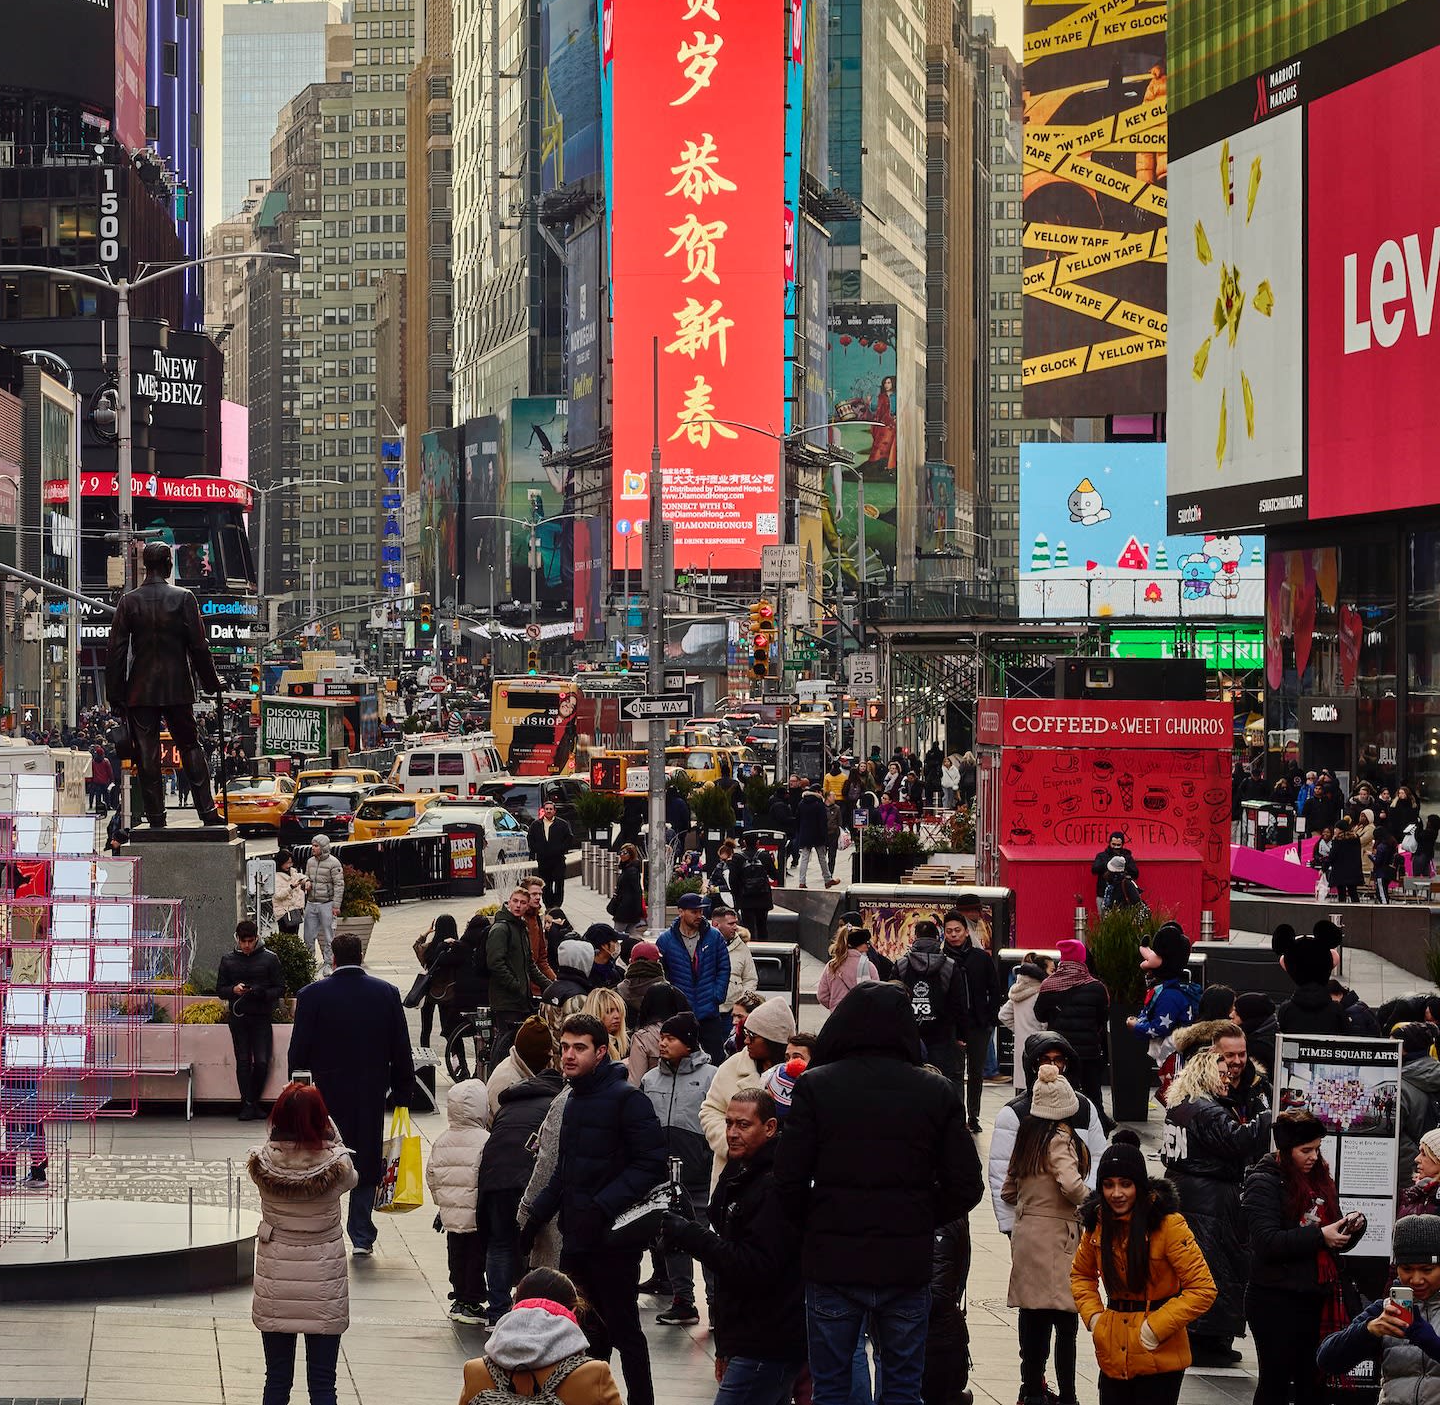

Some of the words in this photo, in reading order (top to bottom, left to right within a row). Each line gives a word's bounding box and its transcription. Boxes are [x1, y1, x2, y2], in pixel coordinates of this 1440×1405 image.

[1104, 20, 1127, 35] KEY
[1130, 12, 1167, 29] GLOCK
[1054, 31, 1083, 46] TAPE
[1269, 60, 1302, 89] MARRIOTT
[1270, 84, 1298, 110] MARQUIS
[1125, 111, 1148, 128] KEY
[1076, 128, 1105, 147] TAPE
[1129, 134, 1166, 145] GLOCK
[1025, 145, 1052, 163] TAPE
[1070, 163, 1094, 179] KEY
[1095, 173, 1131, 194] GLOCK
[100, 168, 119, 263] 1500
[1034, 231, 1079, 245] YELLOW
[1066, 252, 1111, 273] YELLOW
[1114, 243, 1143, 260] TAPE
[664, 133, 739, 449] 恭贺新春
[1075, 292, 1102, 311] TAPE
[1122, 309, 1145, 325] KEY
[1098, 342, 1144, 361] YELLOW
[162, 357, 197, 382] NEW
[1040, 357, 1077, 373] GLOCK
[162, 482, 202, 497] Watch
[206, 483, 226, 498] the
[1178, 505, 1202, 524] swatch
[771, 559, 792, 568] MUST
[210, 624, 234, 640] Dak
[853, 672, 873, 684] 25
[266, 707, 320, 719] DISCOVER
[631, 701, 652, 714] ONE
[661, 699, 684, 712] WAY
[1311, 704, 1338, 722] swatch
[503, 715, 563, 726] VERISHOP
[1012, 715, 1109, 734] COFFEED
[1120, 716, 1161, 734] SWEET
[1165, 718, 1225, 736] CHURROS
[265, 740, 320, 751] SECRETS
[1138, 823, 1168, 843] TEA
[450, 838, 476, 853] JERSEY
[454, 856, 474, 870] BOYS
[911, 1003, 932, 1015] Y-3
[1300, 1047, 1333, 1059] TIMES
[1334, 1048, 1372, 1061] SQUARE
[1373, 1049, 1399, 1061] ARTS
